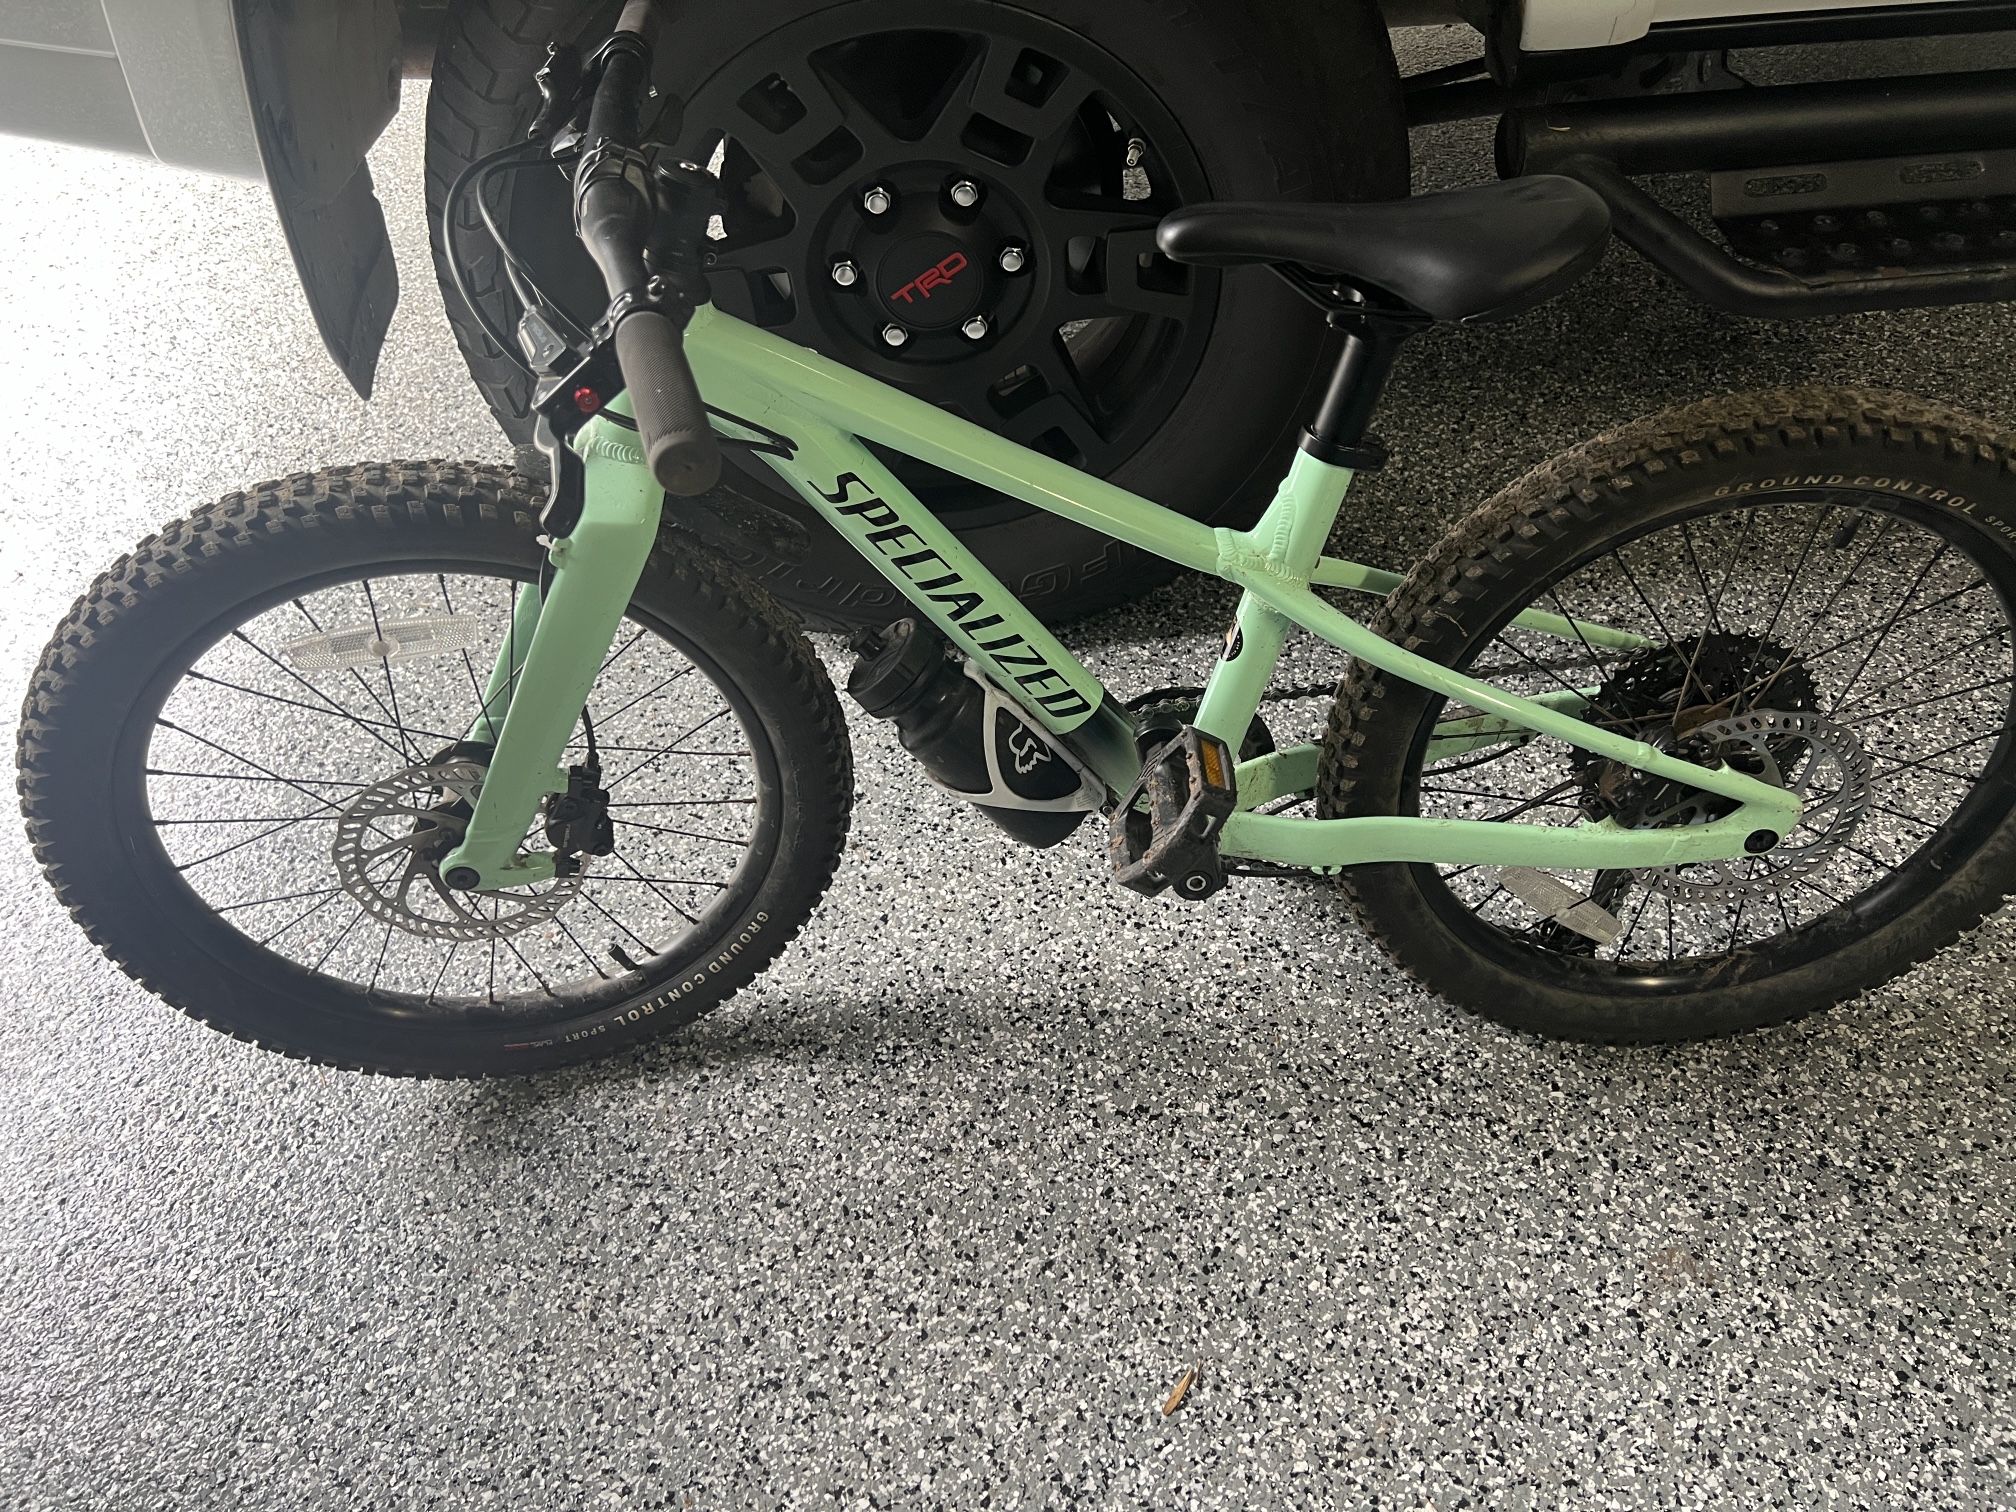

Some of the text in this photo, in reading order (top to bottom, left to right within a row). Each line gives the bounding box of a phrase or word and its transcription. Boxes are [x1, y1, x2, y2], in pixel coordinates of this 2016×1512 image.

[890, 252, 968, 304] TRD
[1714, 474, 2016, 541] GROUND CONTROL SPOR
[806, 471, 1092, 718] SPECIALIZED
[564, 910, 769, 1043] GROUND CONTROL SPORT
